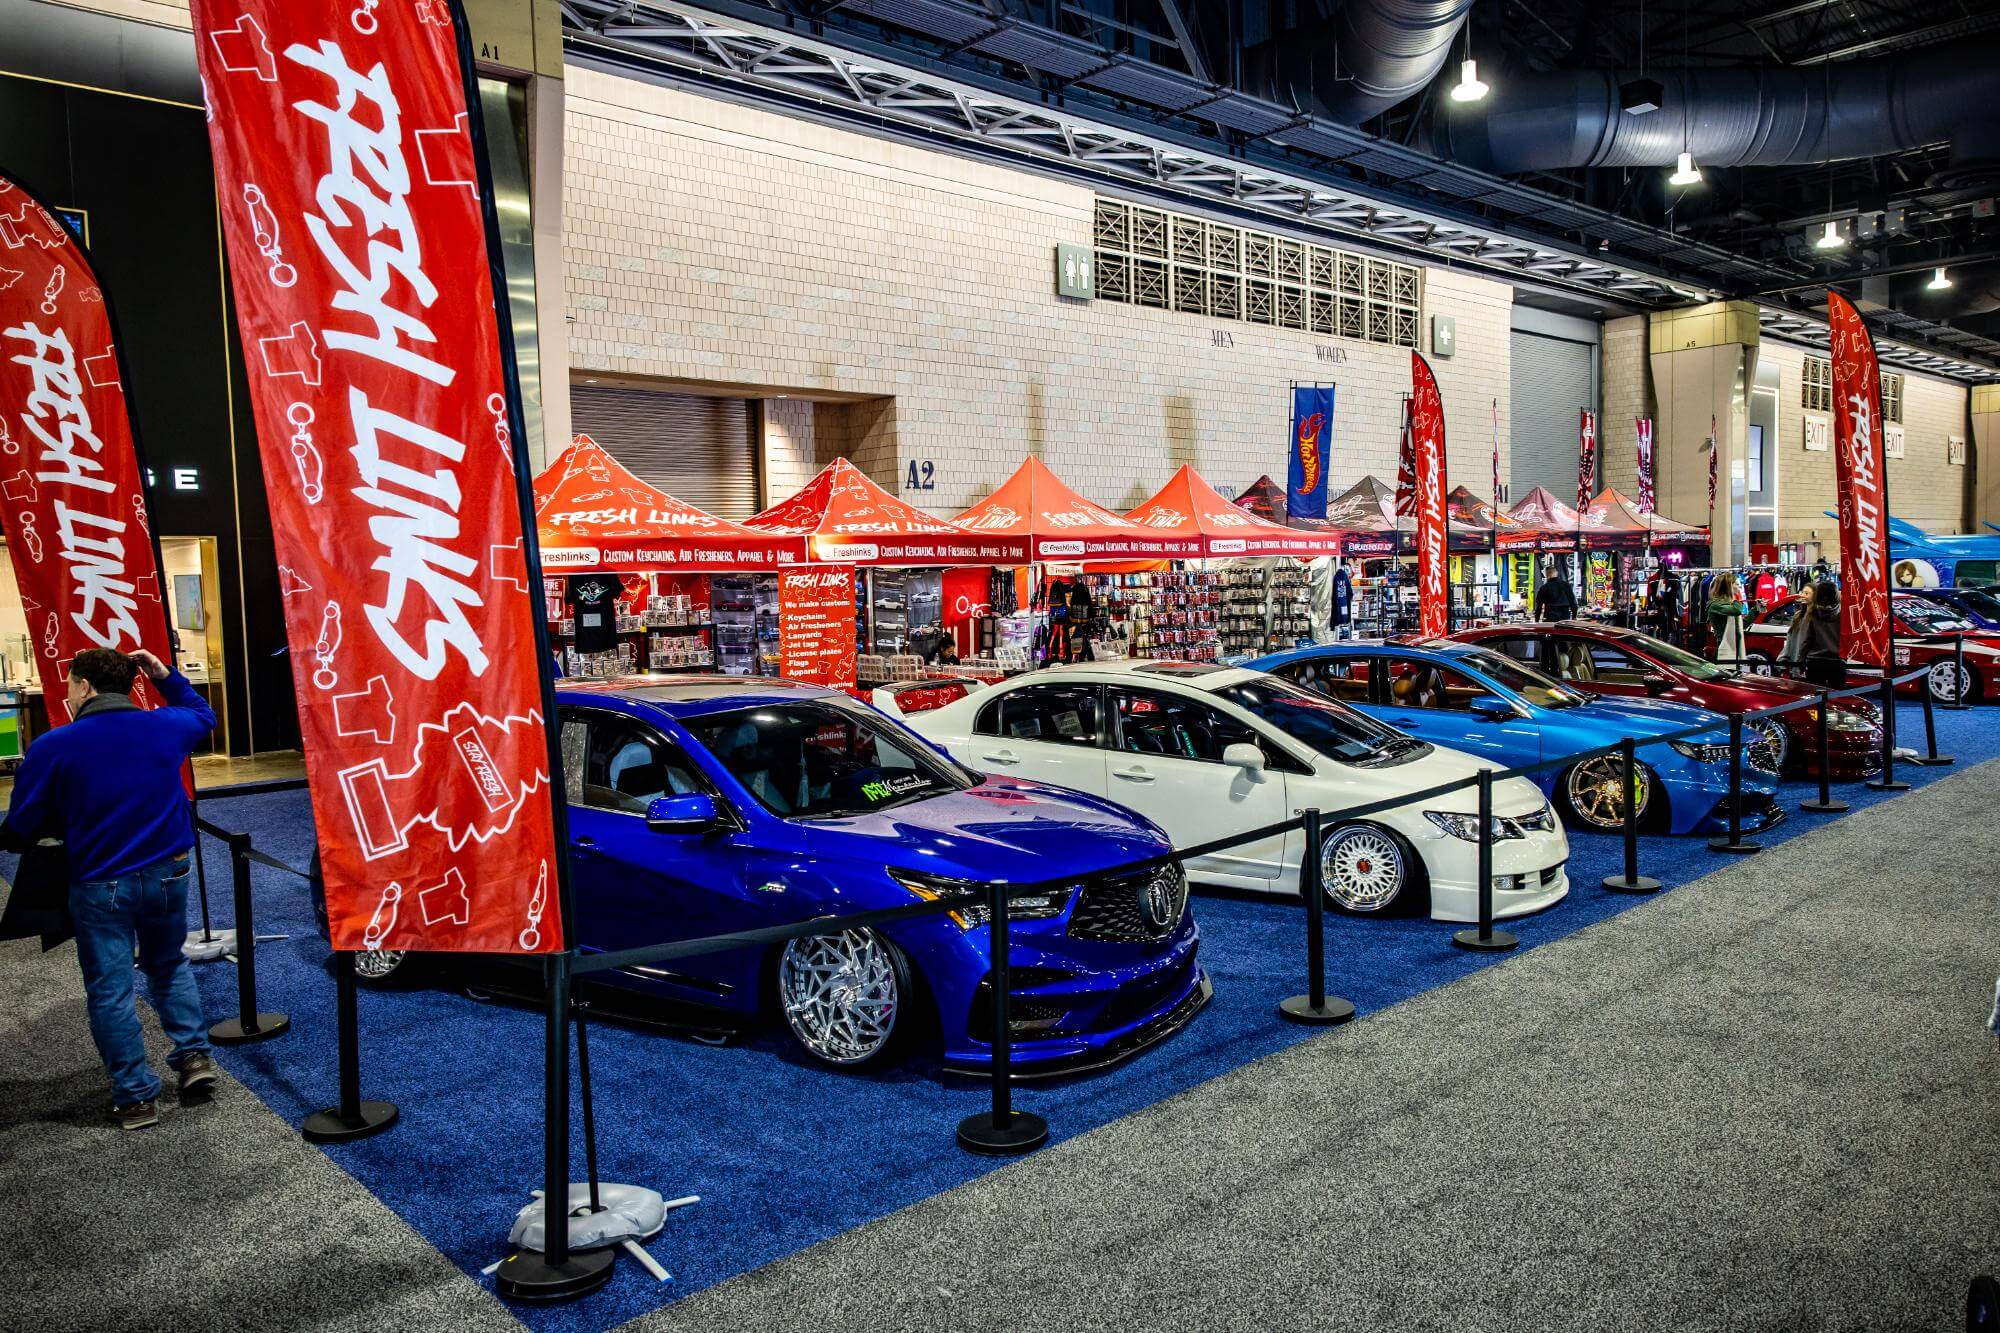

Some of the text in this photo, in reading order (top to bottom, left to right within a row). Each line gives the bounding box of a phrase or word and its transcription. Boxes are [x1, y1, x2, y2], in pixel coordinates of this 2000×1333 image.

[481, 42, 499, 60] A1
[1211, 329, 1234, 348] MEN
[283, 39, 490, 681] FRESH LINKS
[1315, 344, 1347, 364] WOMEN
[1806, 421, 1826, 446] EXIT
[1849, 392, 1877, 492] FRESH
[1886, 432, 1903, 453] EXIT
[1949, 440, 1964, 460] EXIT
[904, 459, 935, 490] A2
[1425, 438, 1442, 522] FRESH
[2, 321, 142, 650] FRESH LINKS
[549, 507, 719, 527] FRESH LINKS
[832, 521, 899, 534] FRESH
[905, 521, 960, 534] LINKS
[1855, 493, 1881, 582] LINKS
[1427, 523, 1443, 596] LINKS
[543, 581, 559, 591] FIRE
[785, 572, 850, 588] FRESH LINKS
[785, 601, 797, 609] We
[800, 622, 842, 630] Fresheners
[802, 641, 819, 649] tags
[819, 648, 843, 656] plates
[462, 740, 504, 797] STAY FRESH
